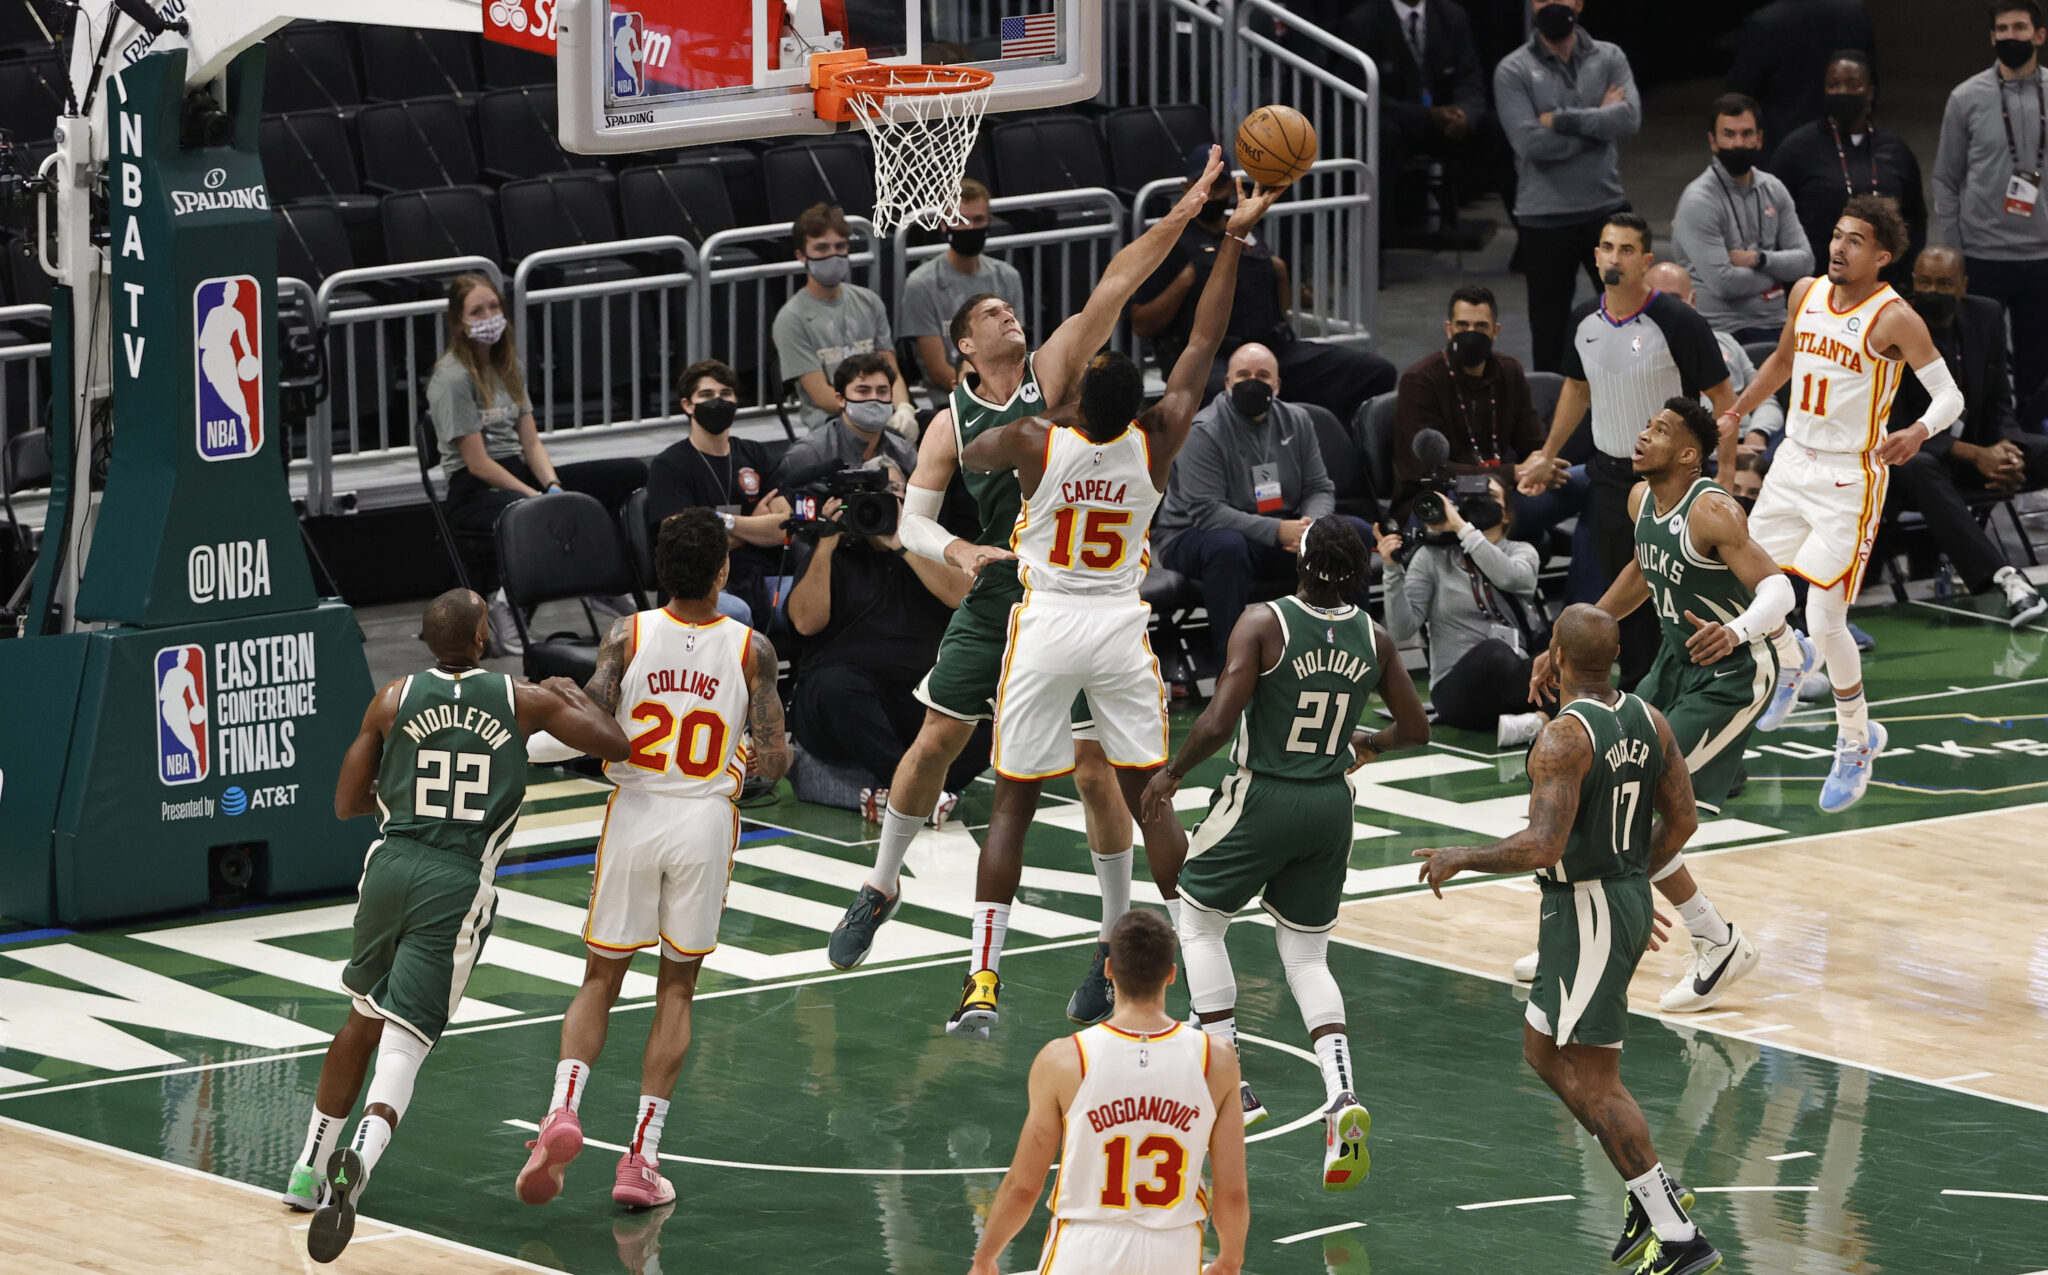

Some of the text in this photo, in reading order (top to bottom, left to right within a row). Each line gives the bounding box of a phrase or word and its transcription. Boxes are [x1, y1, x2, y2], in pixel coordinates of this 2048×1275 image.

[617, 79, 633, 94] NBA
[605, 111, 655, 129] SPALDING
[171, 185, 269, 216] SPALDING
[123, 281, 146, 379] TV
[1800, 371, 1830, 418] 11
[206, 418, 238, 450] NBA
[1061, 479, 1127, 504] CAPELA
[1048, 505, 1133, 571] 15
[188, 538, 271, 604] @NBA
[1636, 542, 1685, 586] UCKS
[215, 631, 316, 691] EASTERN
[1291, 648, 1372, 684] HOLIDAY
[216, 681, 317, 727] CONFERENCE
[646, 669, 720, 701] COLLINS
[402, 704, 513, 751] MIDDLETON
[626, 699, 730, 781] 20
[1285, 690, 1351, 756] 21
[166, 752, 191, 777] NBA
[218, 720, 296, 777] FINALS
[1604, 737, 1650, 773] TUCKER
[161, 783, 300, 822] Presented by AT&T
[414, 748, 491, 822] 22
[1611, 780, 1641, 855] 17
[1100, 1133, 1189, 1210] 13
